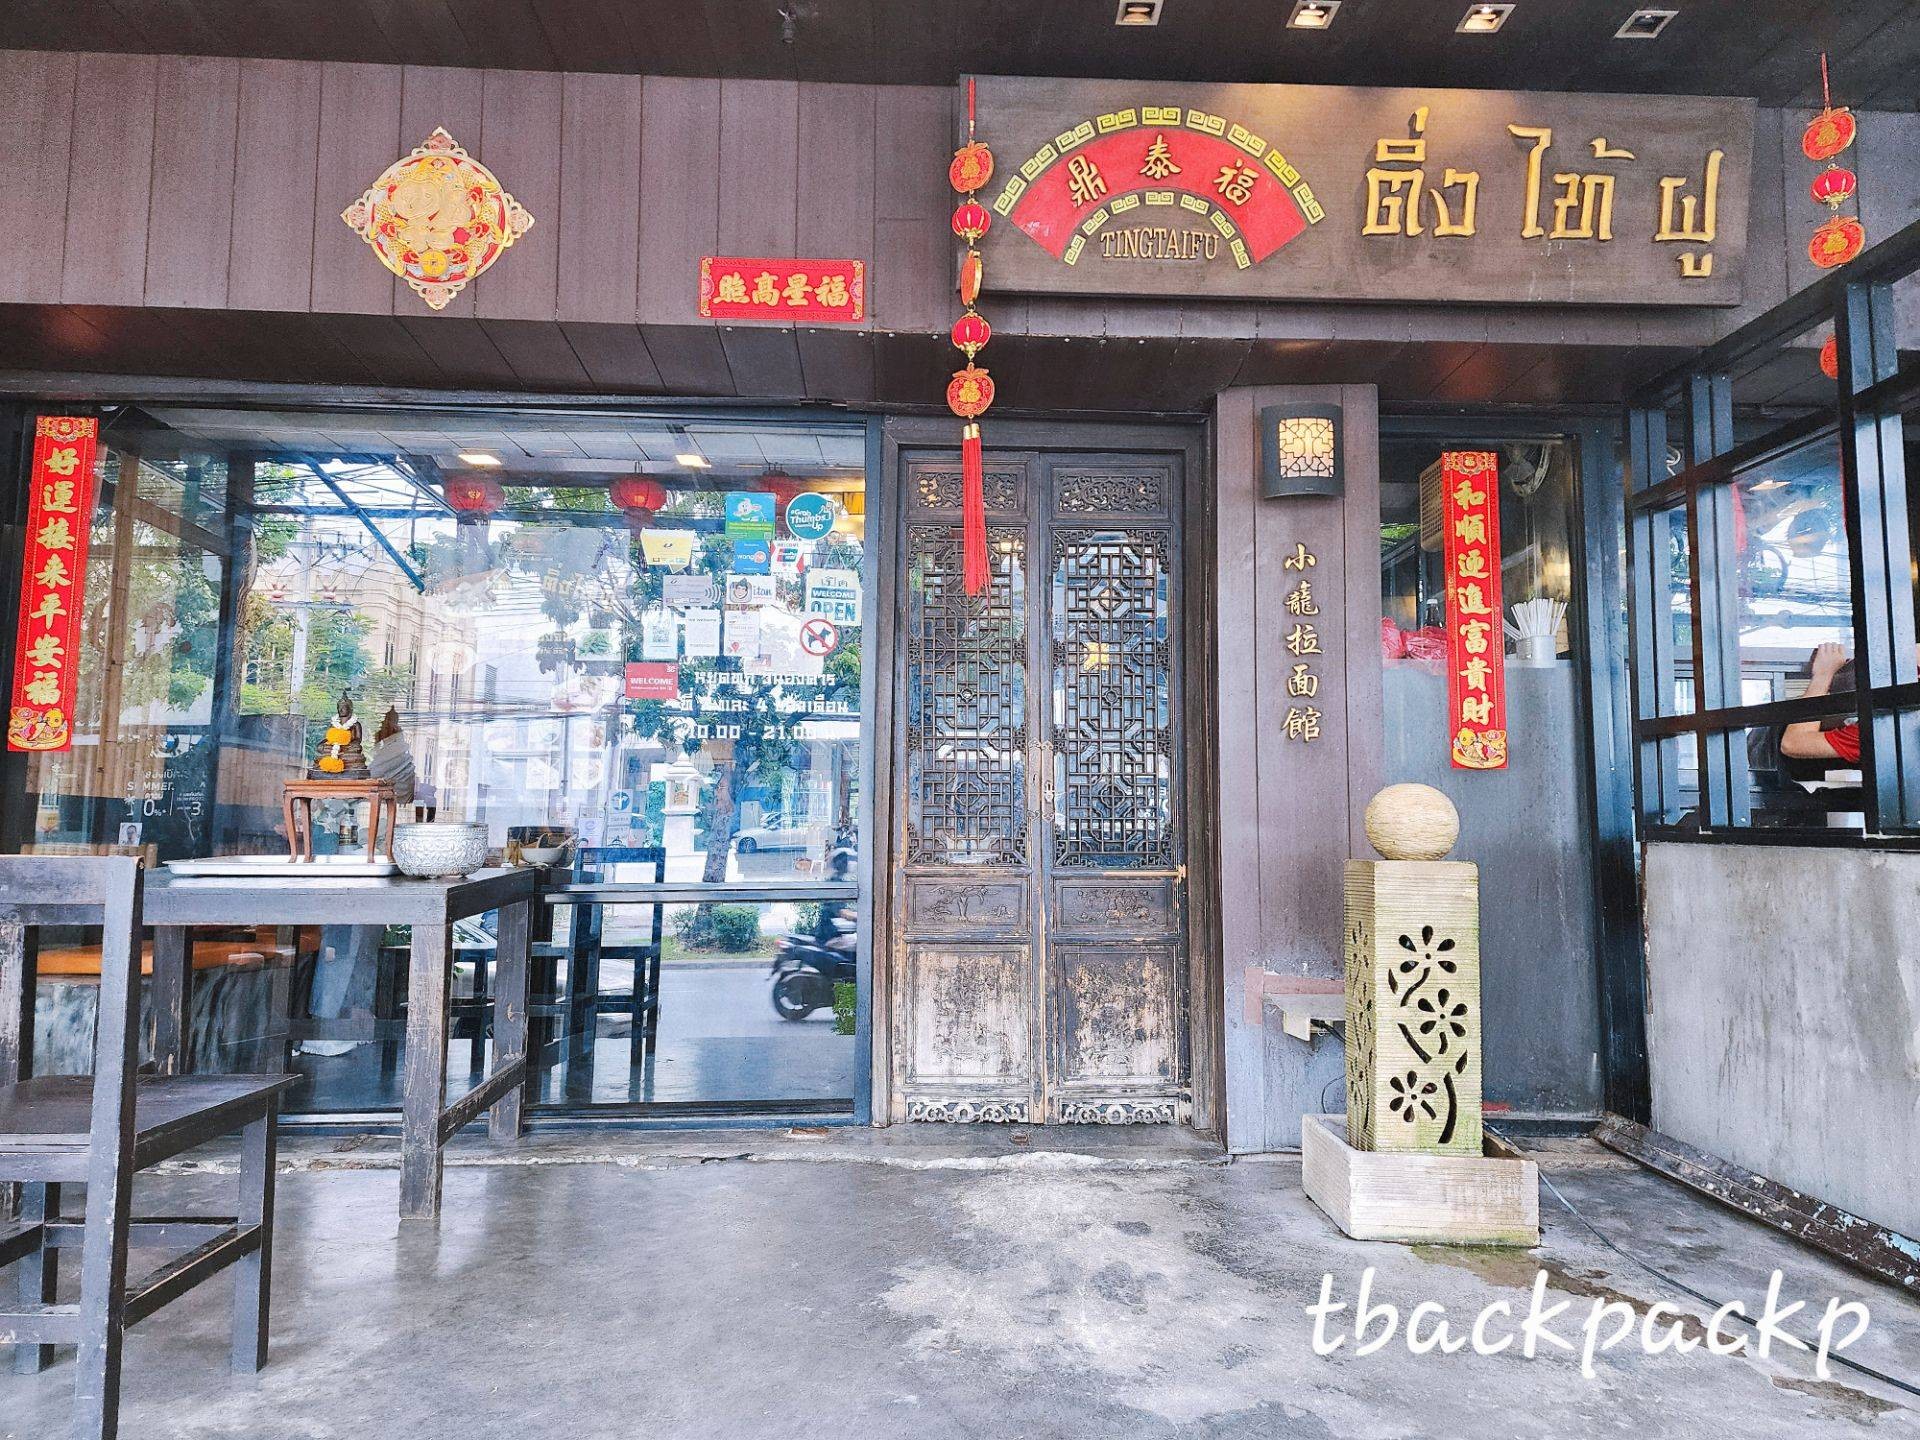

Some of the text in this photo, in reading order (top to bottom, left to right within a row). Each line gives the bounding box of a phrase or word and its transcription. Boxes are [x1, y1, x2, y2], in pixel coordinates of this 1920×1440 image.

[1067, 133, 1260, 207] 鼎泰福
[1100, 227, 1220, 260] TINGTAIFU
[811, 589, 855, 599] WELCOME
[810, 600, 856, 621] OPEN
[1282, 543, 1323, 742] 小龍拉面館
[630, 677, 674, 686] WELCOME
